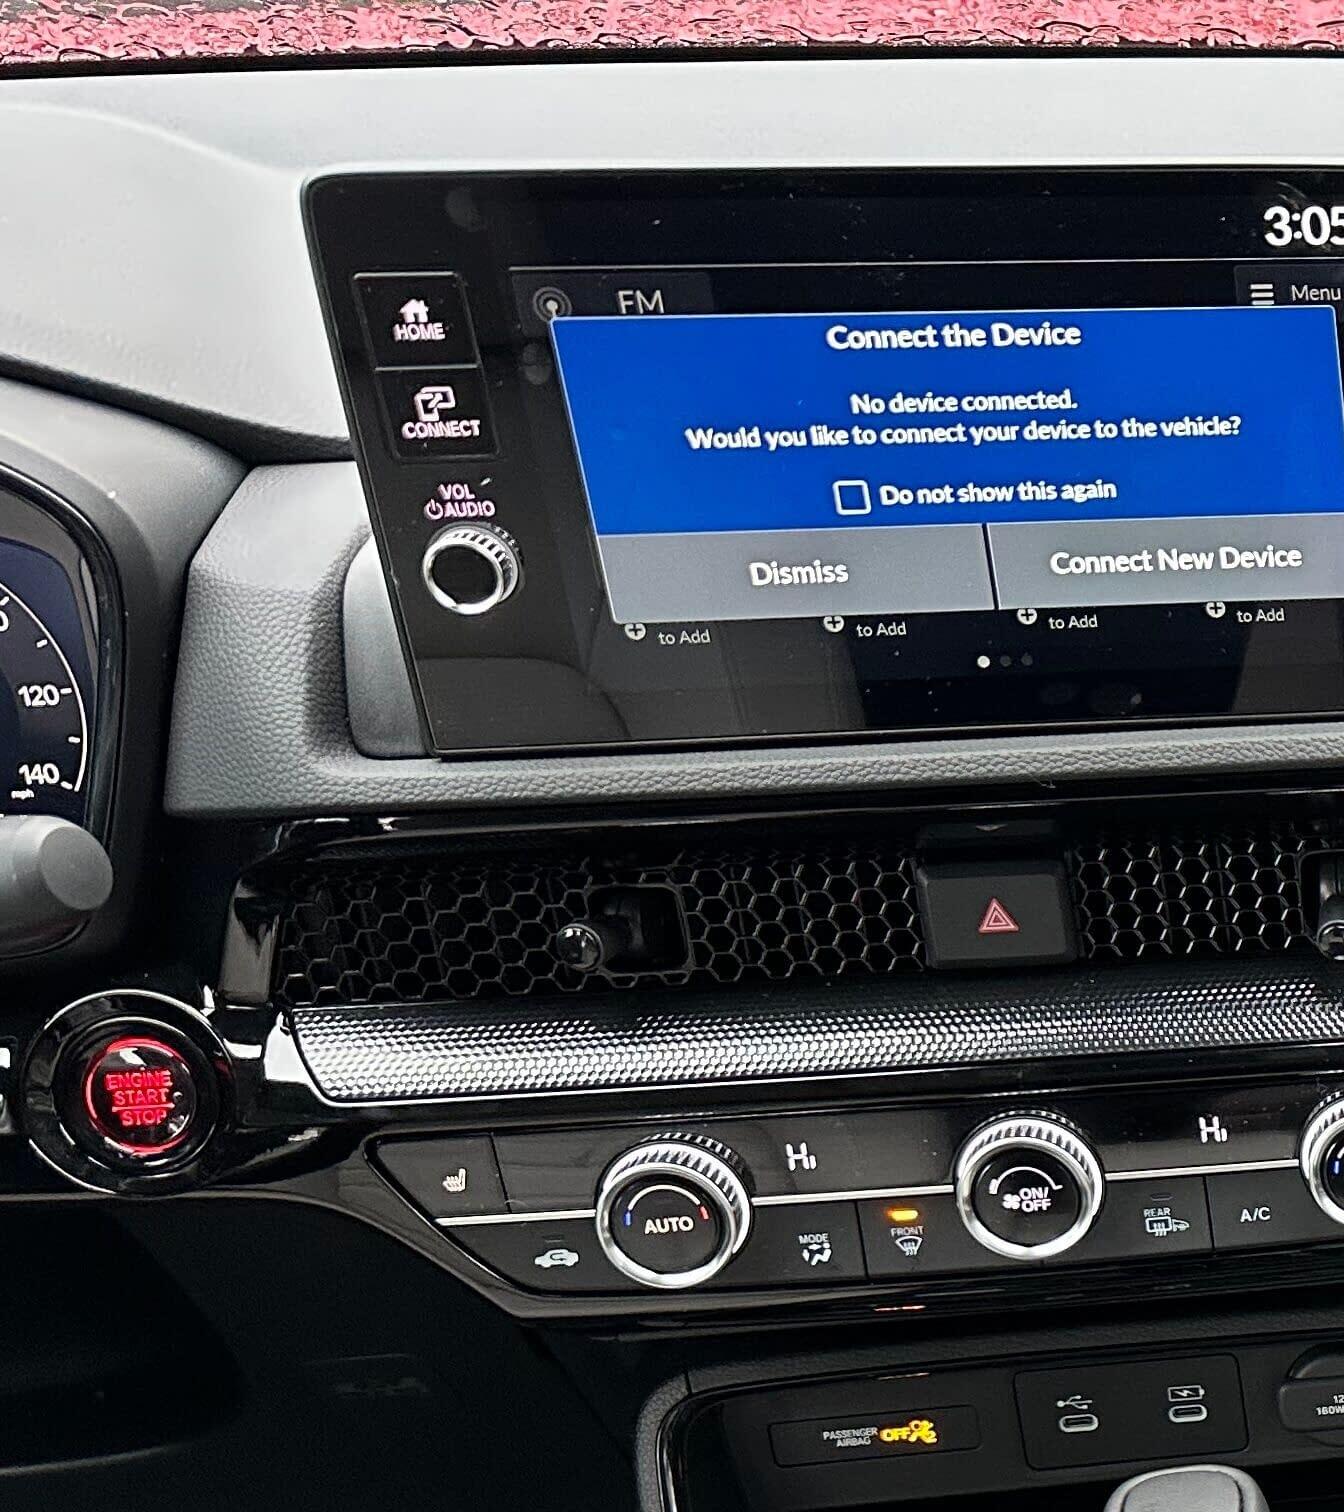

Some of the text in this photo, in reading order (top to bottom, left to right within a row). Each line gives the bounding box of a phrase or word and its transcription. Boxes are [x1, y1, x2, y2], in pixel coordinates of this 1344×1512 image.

[1292, 284, 1341, 302] Menu
[618, 290, 664, 314] FM
[394, 323, 445, 341] HOME
[826, 322, 1081, 351] Connect the Device
[851, 389, 1078, 415] No device connected.
[402, 421, 480, 439] CONNECT
[685, 416, 1241, 452] Would you like to connect your device to the vehicle?
[439, 484, 475, 500] VOL
[880, 480, 1117, 506] Do not show this again
[445, 501, 495, 519] AUDIO
[1051, 544, 1302, 575] Connect New Device
[750, 561, 848, 587] Dismiss
[1049, 613, 1097, 629] to Add
[1237, 607, 1284, 623] to Add
[658, 629, 711, 645] to Add
[856, 622, 906, 637] to Add
[18, 684, 60, 707] 120
[18, 763, 60, 785] 140
[105, 1070, 173, 1090] ENGINE
[114, 1088, 169, 1105] START
[122, 1110, 167, 1126] STOP
[1019, 1187, 1049, 1201] ON/
[1022, 1197, 1052, 1212] OFF
[1144, 1208, 1170, 1217] REAR
[1240, 1207, 1270, 1222] A/C
[644, 1217, 694, 1234] AUTO
[891, 1227, 924, 1237] FRONT
[799, 1233, 829, 1245] MODE
[823, 1427, 878, 1440] PASSENGER
[837, 1436, 871, 1447] AIRBAG
[880, 1427, 910, 1441] OFF
